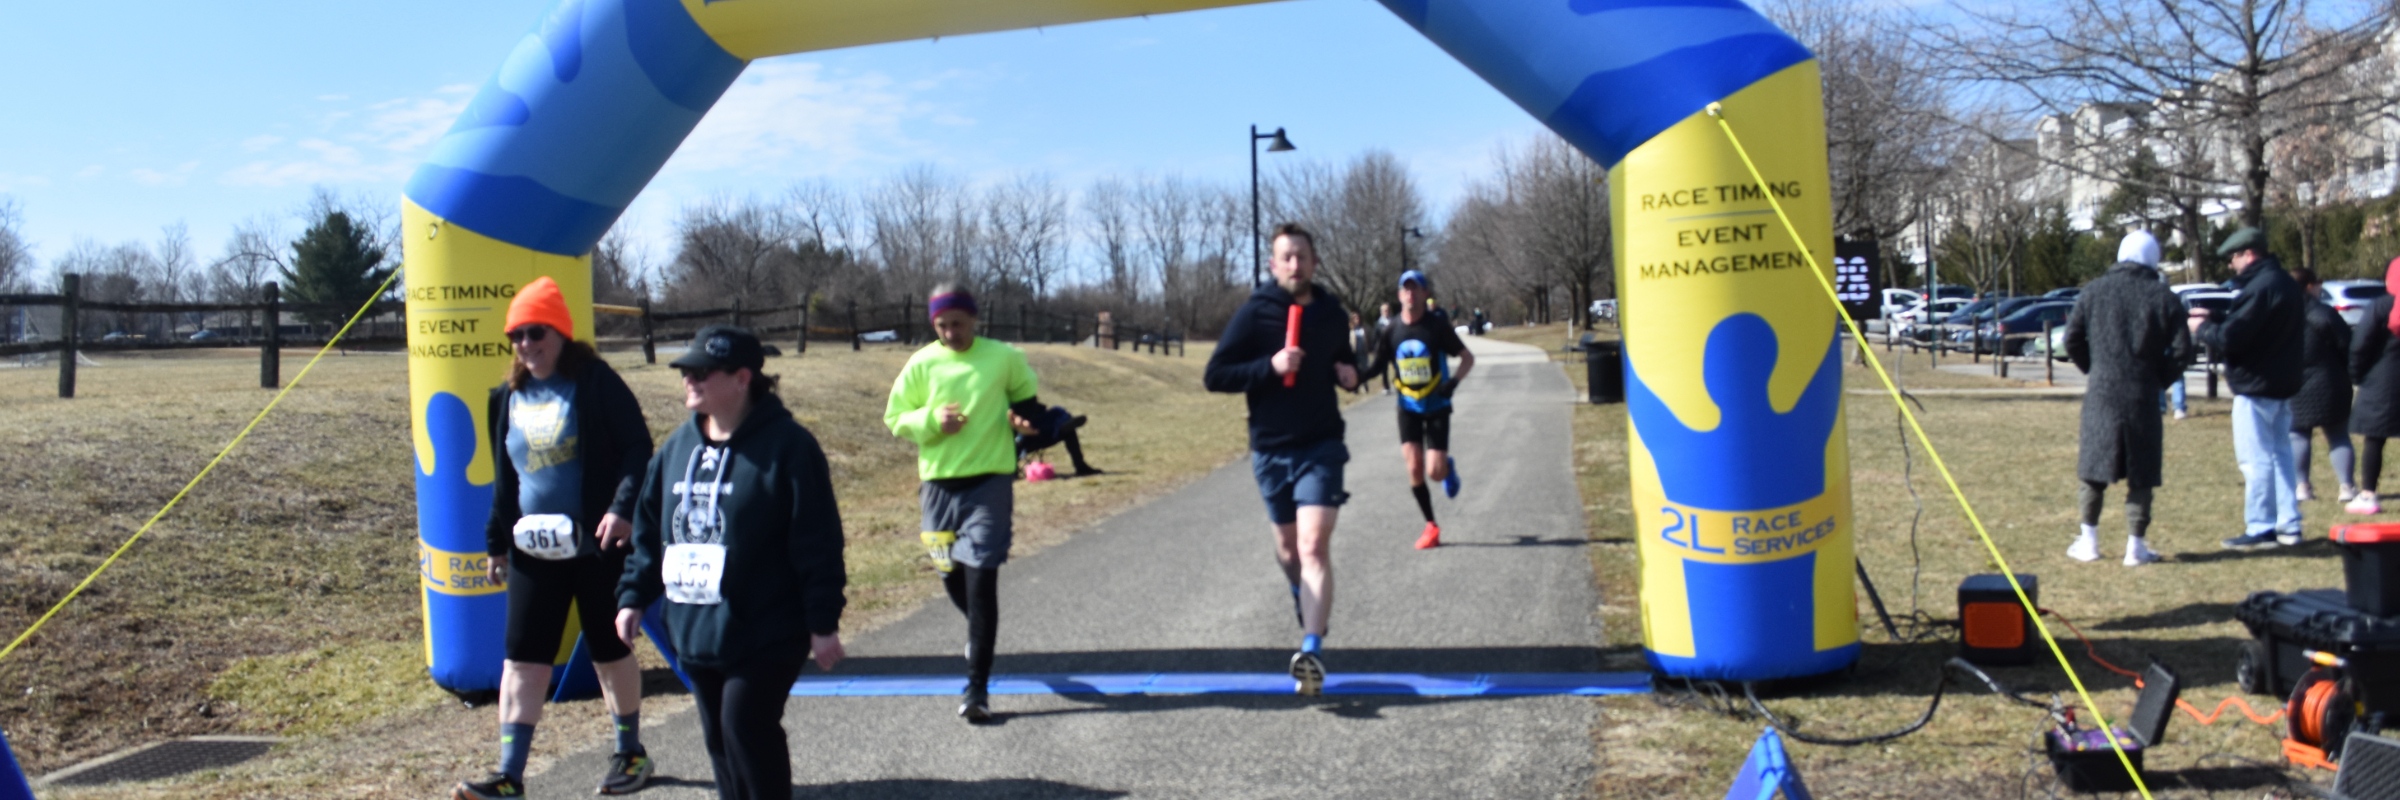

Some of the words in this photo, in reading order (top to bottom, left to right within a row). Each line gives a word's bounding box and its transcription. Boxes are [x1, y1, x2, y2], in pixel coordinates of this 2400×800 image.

[1641, 187, 1708, 211] RACE
[1678, 223, 1768, 247] EVENT
[440, 284, 516, 300] TIMING
[419, 319, 479, 334] EVENT
[408, 343, 513, 358] ANAGEMEN
[1661, 506, 1726, 555] 2L
[1732, 510, 1802, 535] RACE
[525, 528, 561, 550] 361
[1734, 515, 1836, 556] SERVICES
[449, 557, 488, 572] RAC
